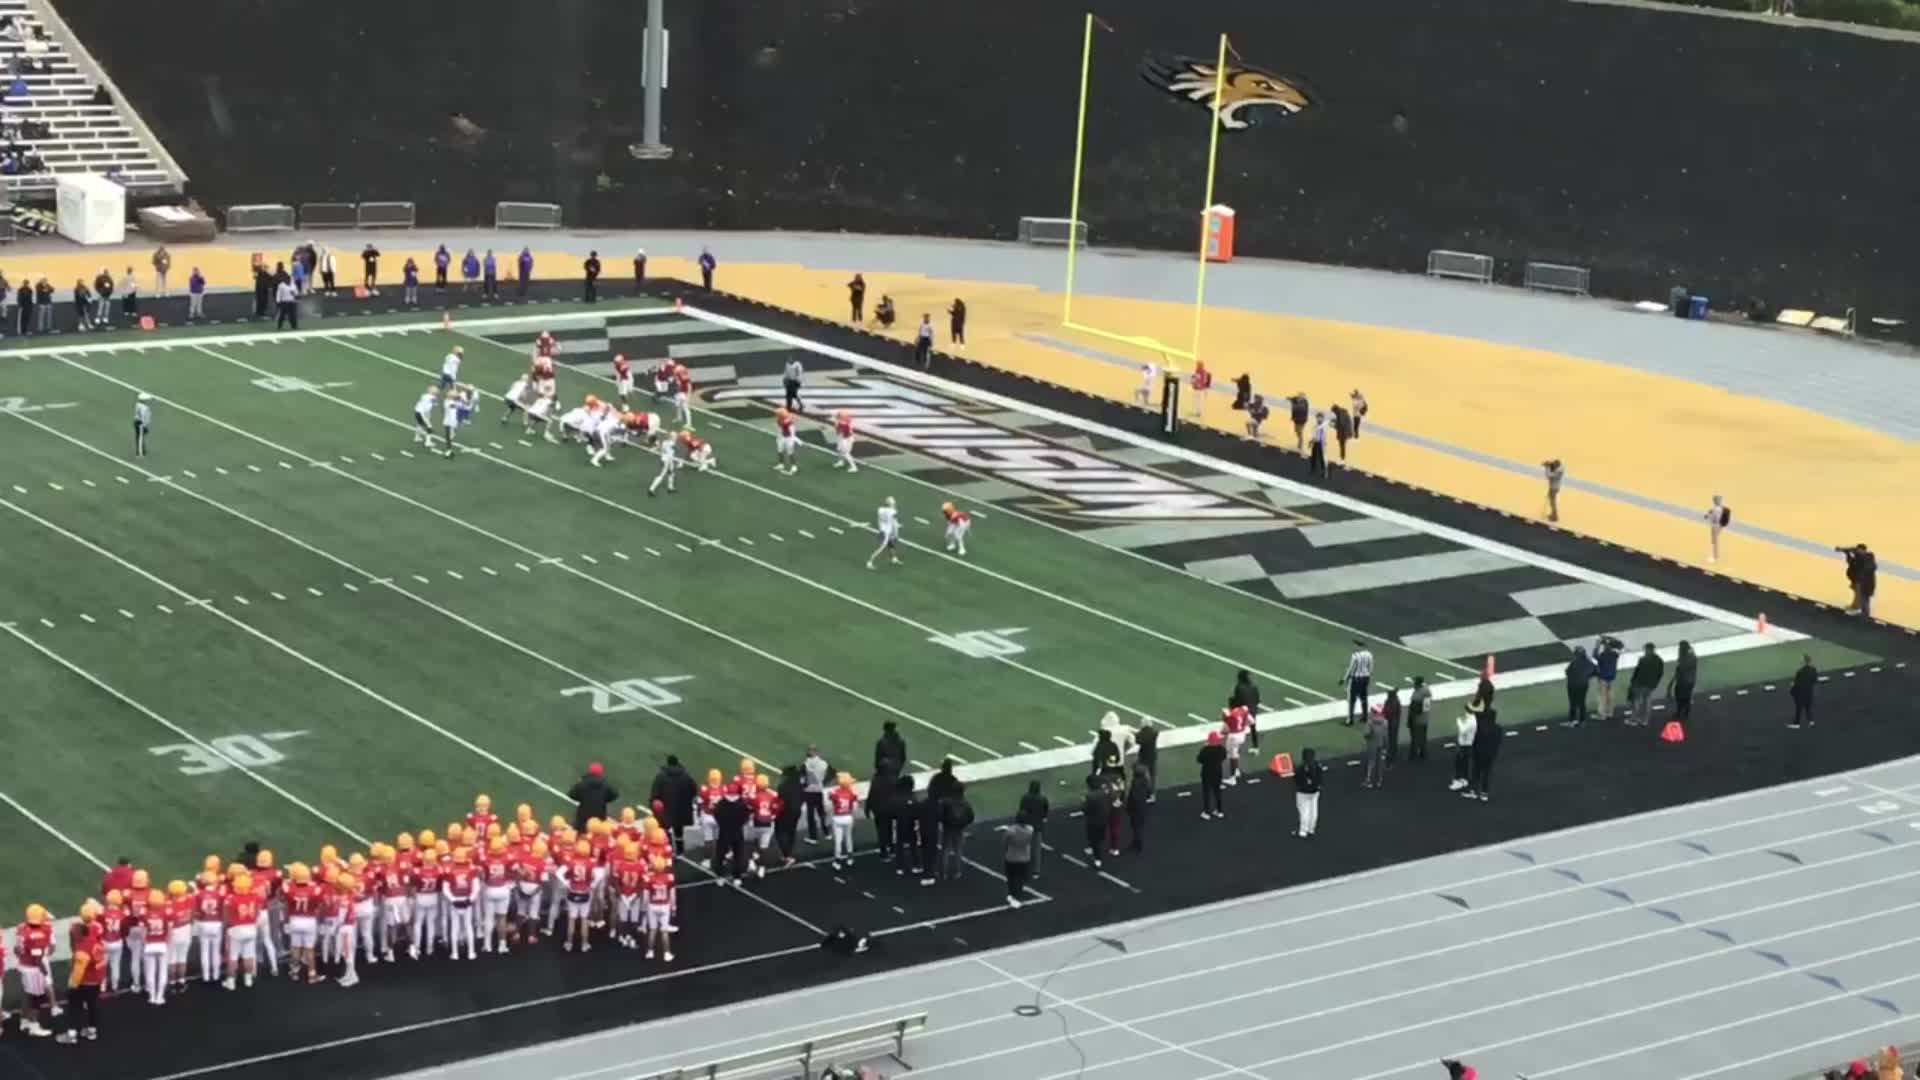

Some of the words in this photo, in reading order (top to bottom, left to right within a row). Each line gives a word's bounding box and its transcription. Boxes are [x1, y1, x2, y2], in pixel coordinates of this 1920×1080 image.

[927, 629, 1027, 658] 10
[561, 677, 684, 714] 20
[149, 733, 288, 776] 30
